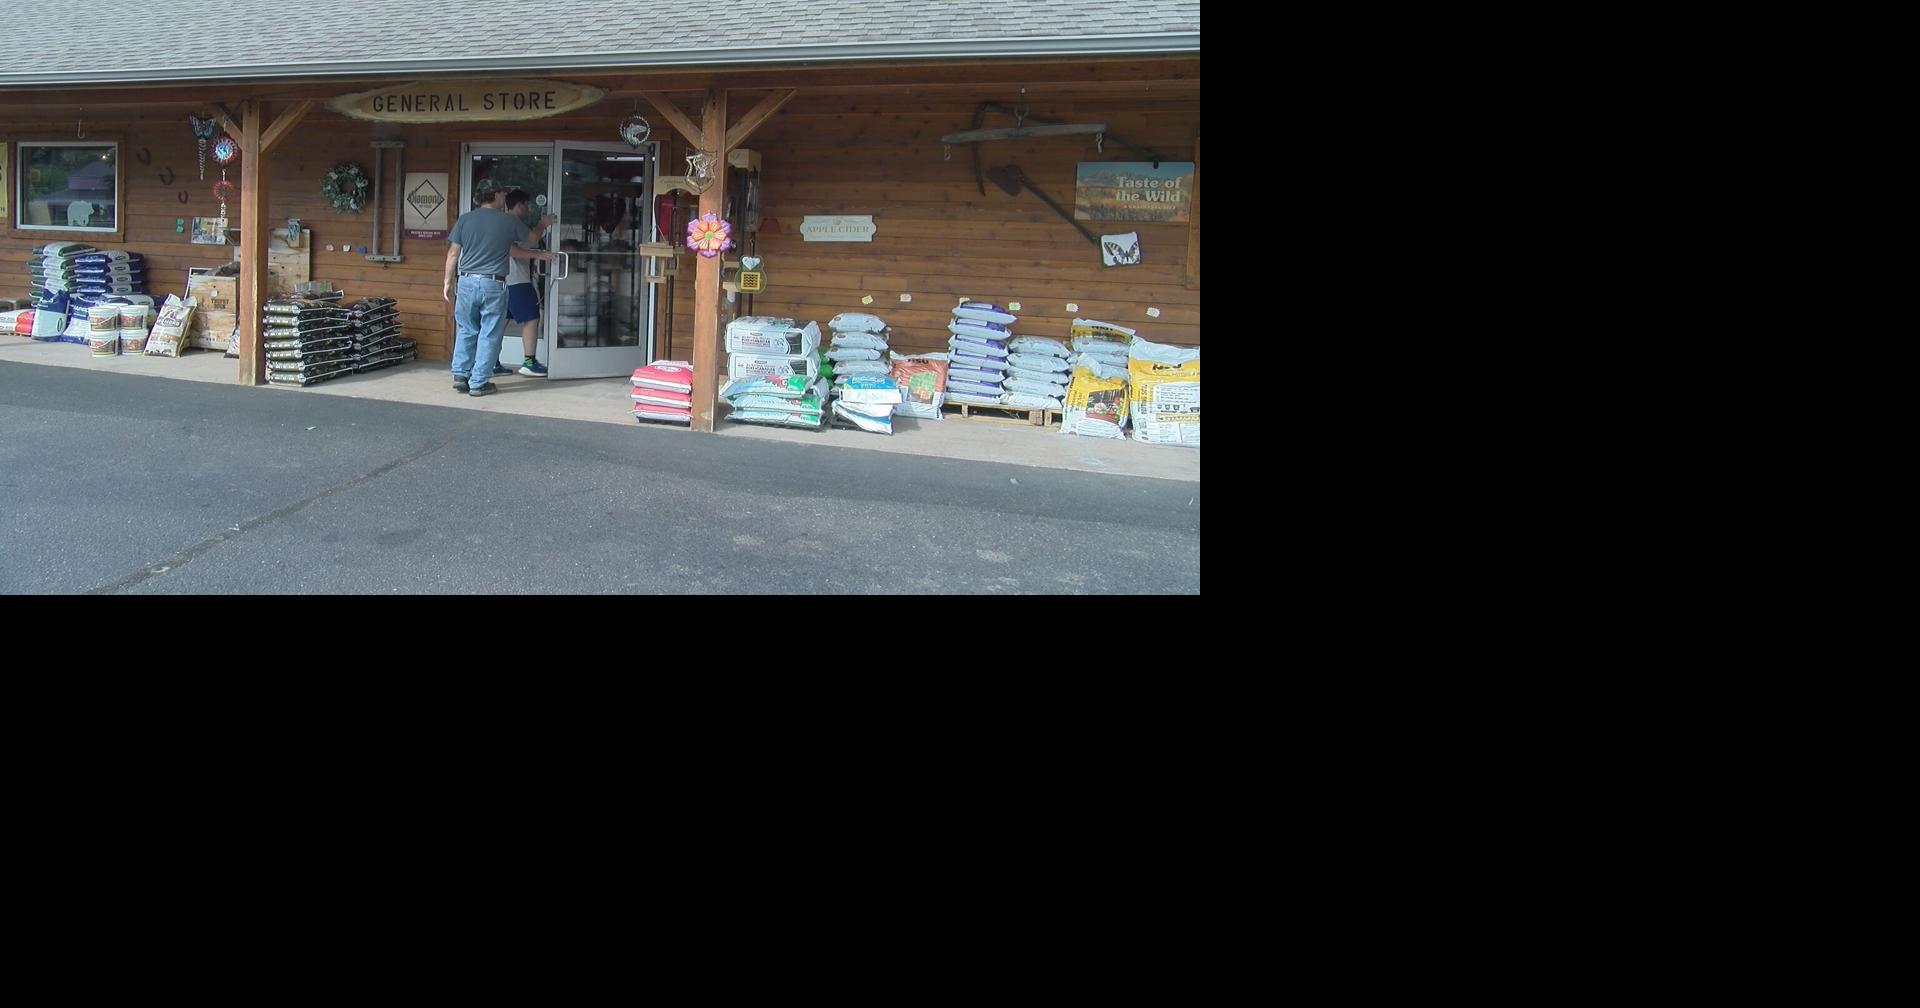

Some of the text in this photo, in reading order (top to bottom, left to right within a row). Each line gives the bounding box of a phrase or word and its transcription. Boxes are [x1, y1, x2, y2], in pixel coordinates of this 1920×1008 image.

[373, 91, 556, 113] GENERAL STORE
[1116, 176, 1183, 188] Taste of
[408, 191, 442, 205] Diamond
[1115, 190, 1181, 202] the Wild
[806, 225, 869, 233] APPLE CIDER
